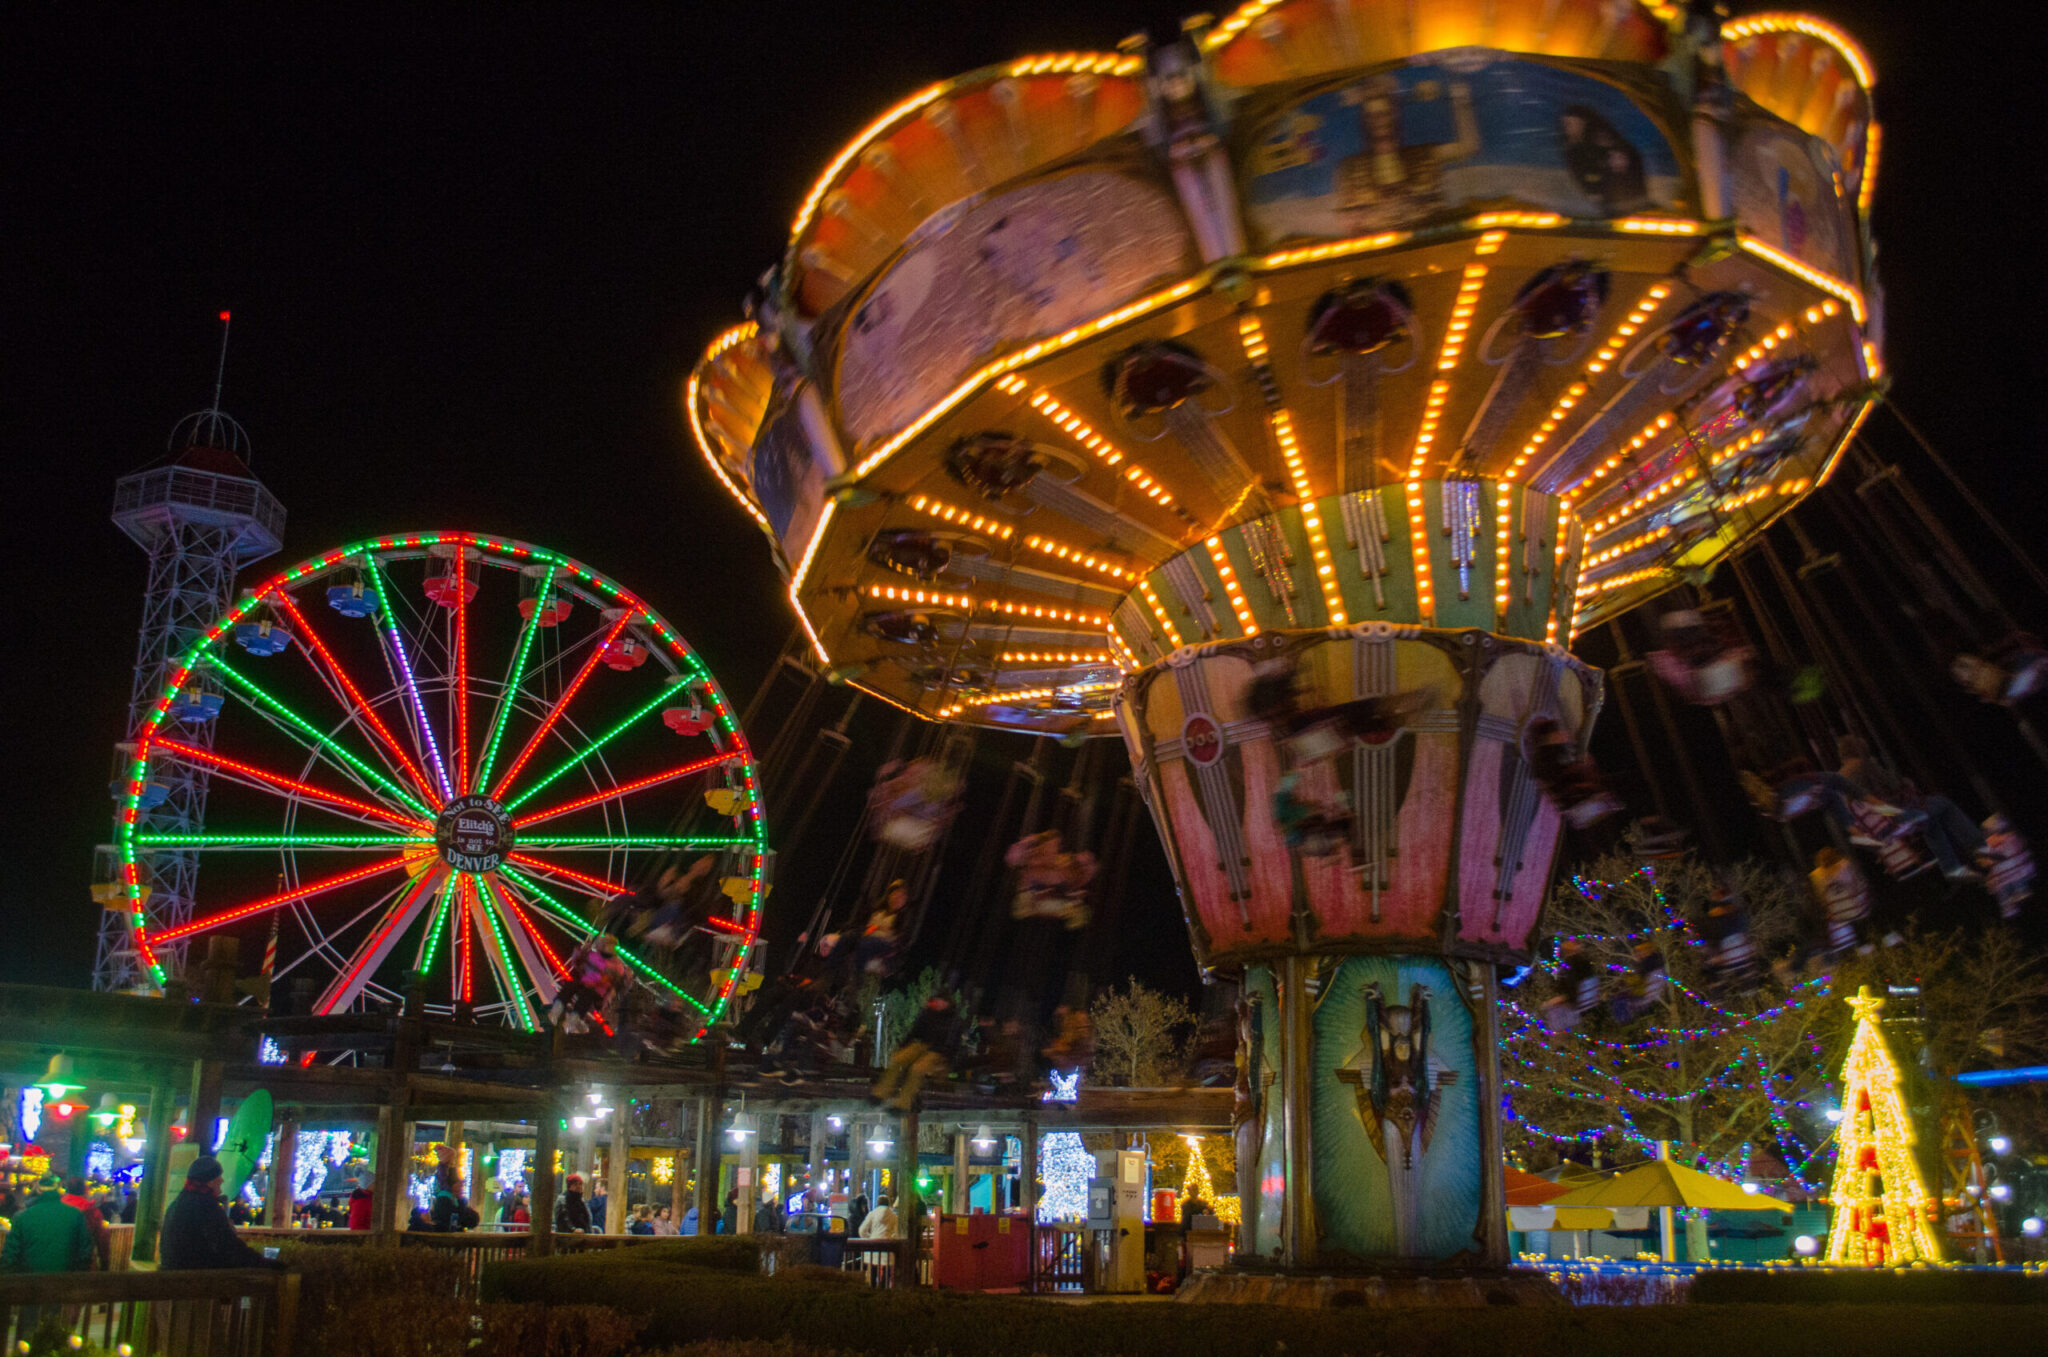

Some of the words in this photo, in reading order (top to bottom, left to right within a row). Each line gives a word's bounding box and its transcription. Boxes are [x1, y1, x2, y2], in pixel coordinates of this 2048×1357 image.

[443, 801, 466, 820] Not
[470, 798, 483, 807] to
[484, 799, 512, 824] SEE
[458, 818, 495, 833] Elitch's
[466, 844, 483, 852] SEE
[447, 848, 500, 871] DENVER
